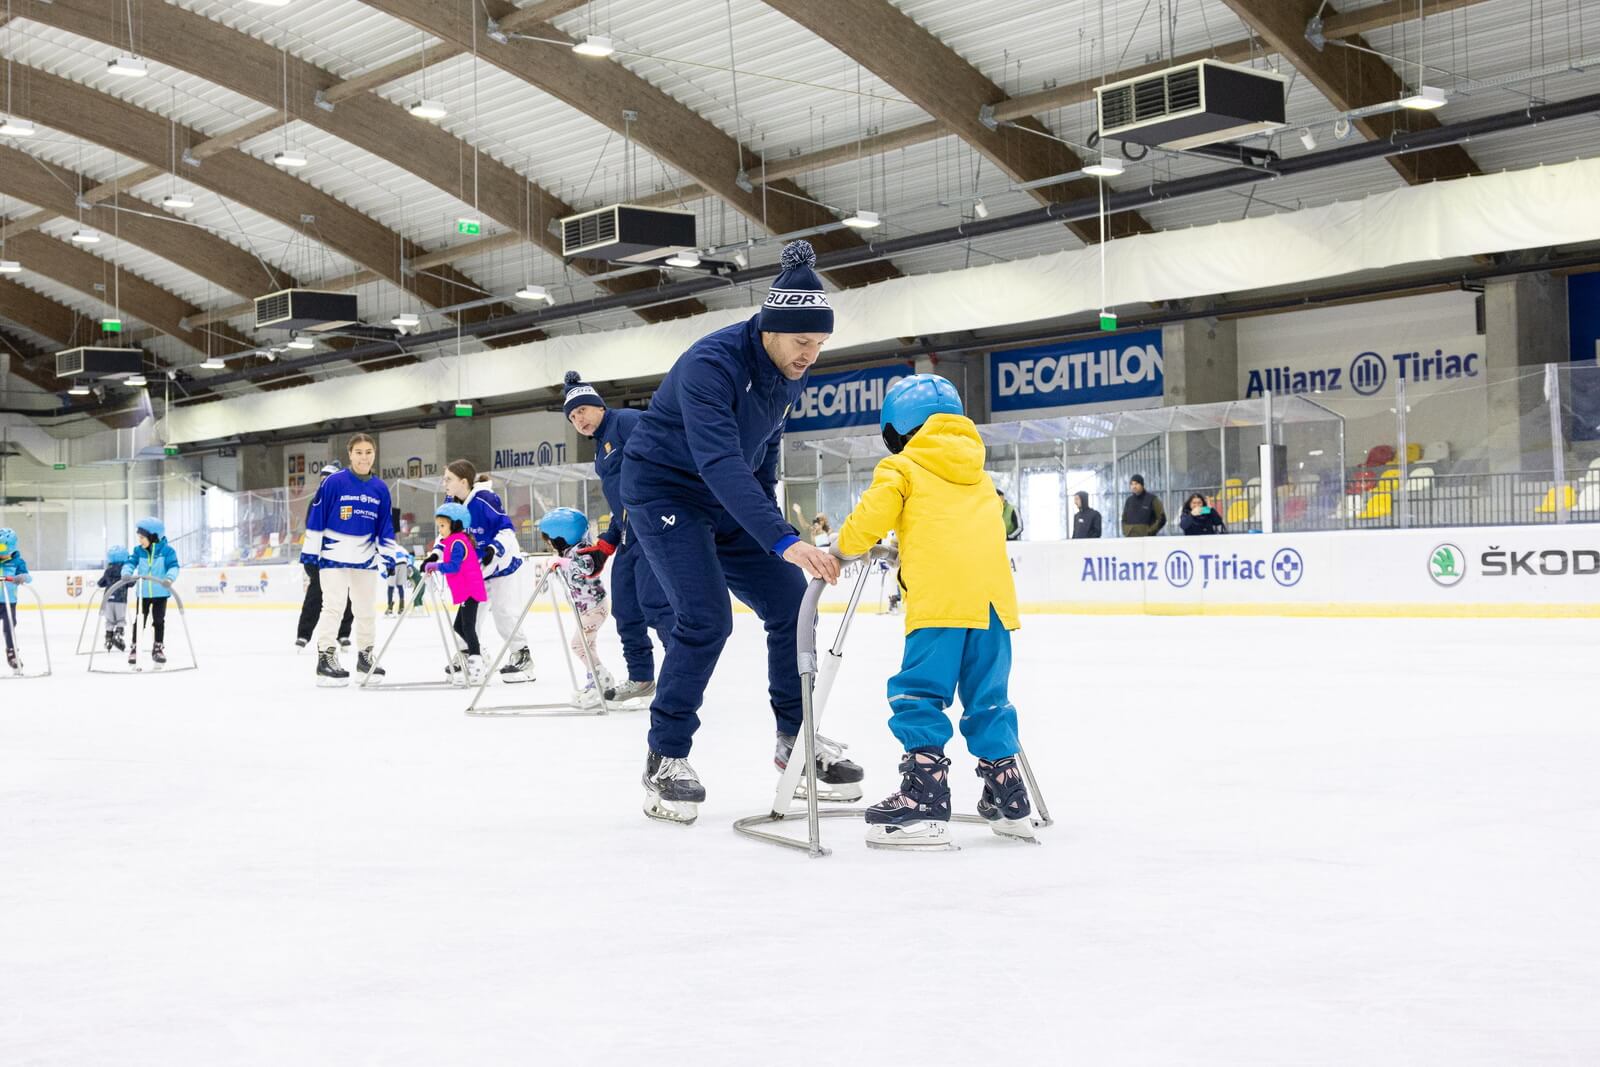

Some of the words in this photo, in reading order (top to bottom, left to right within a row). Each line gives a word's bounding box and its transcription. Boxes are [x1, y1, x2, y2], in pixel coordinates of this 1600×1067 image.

[998, 344, 1163, 396] DECATHLON
[1246, 366, 1342, 399] Allianz
[789, 376, 905, 419] DECATHL
[495, 448, 535, 469] Allianz
[1081, 557, 1159, 582] Allianz
